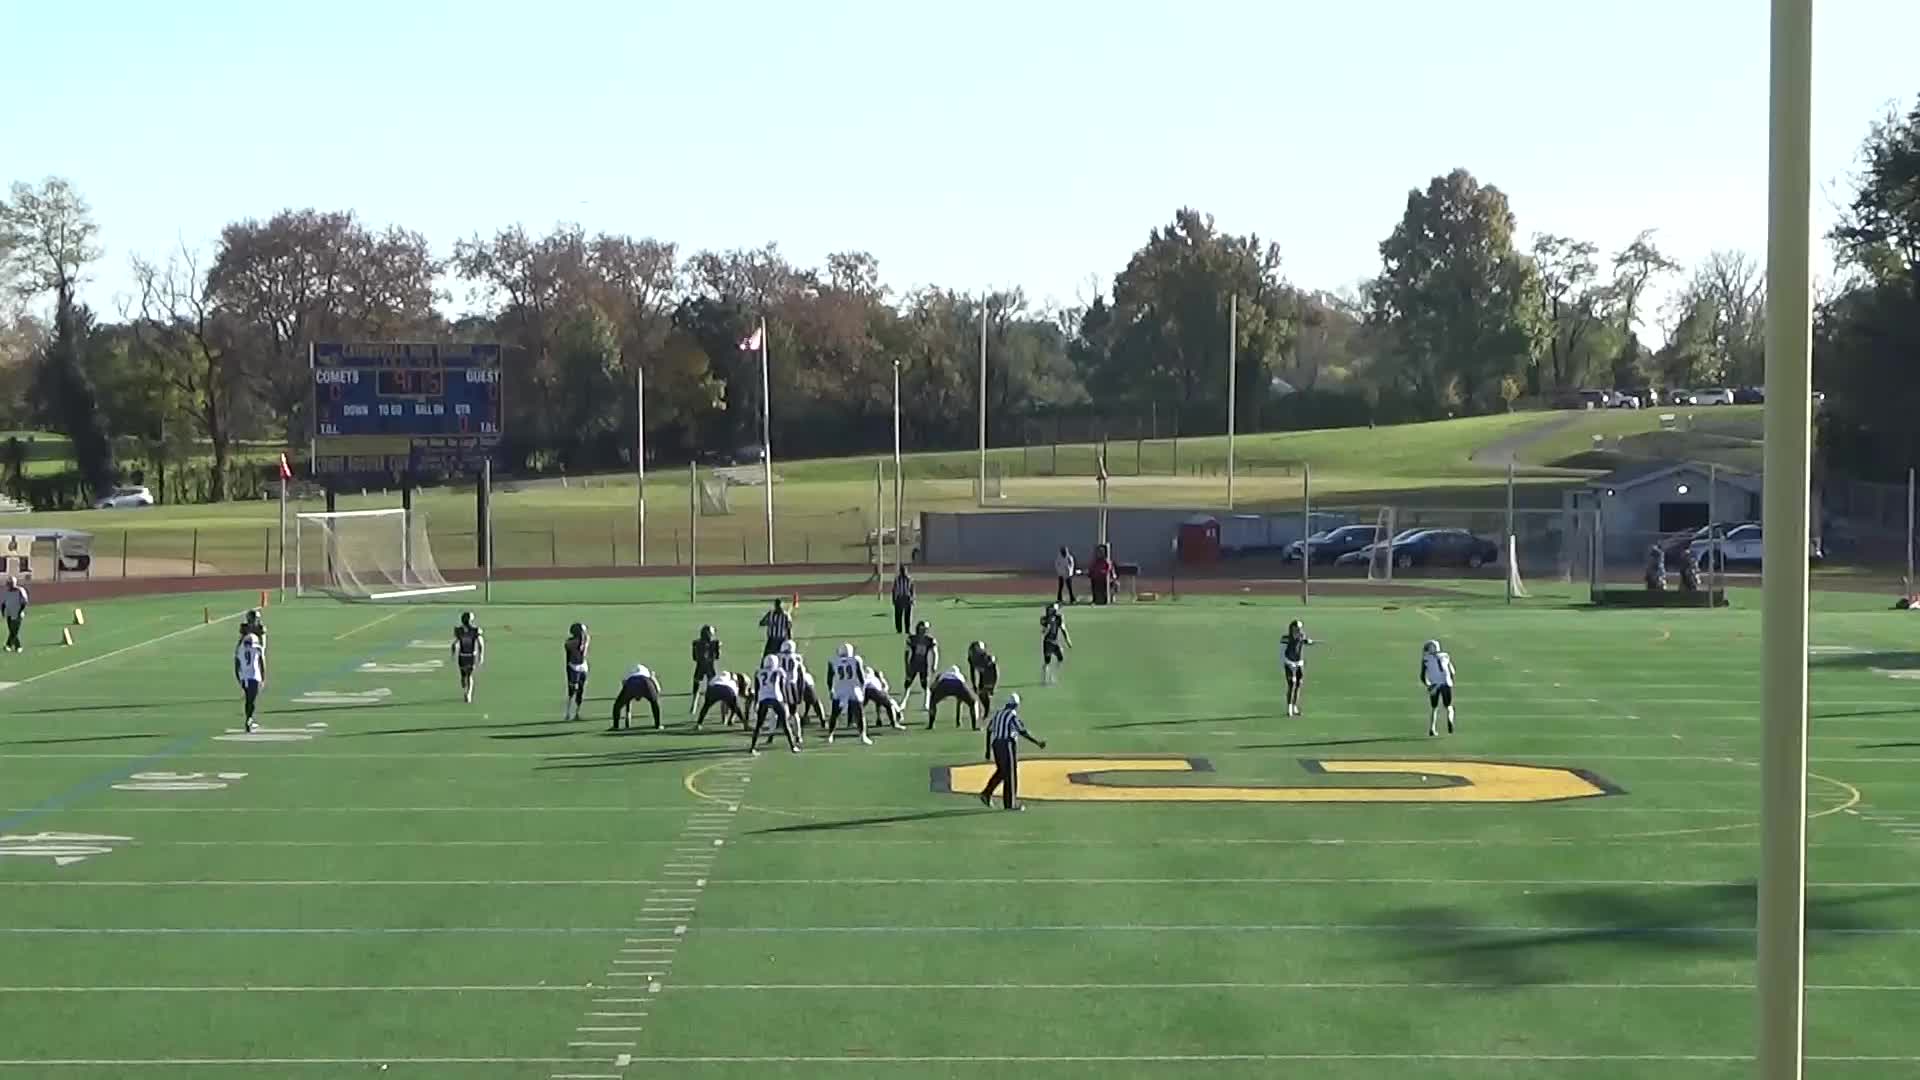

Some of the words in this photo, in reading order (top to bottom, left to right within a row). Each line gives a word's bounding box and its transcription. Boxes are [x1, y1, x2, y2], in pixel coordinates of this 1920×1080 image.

[316, 370, 359, 384] COMETS
[466, 370, 500, 383] GUEST
[344, 404, 368, 416] DOWN
[378, 404, 389, 416] TO
[391, 404, 403, 416] GO
[415, 404, 432, 416] BALL
[455, 404, 471, 416] QTR
